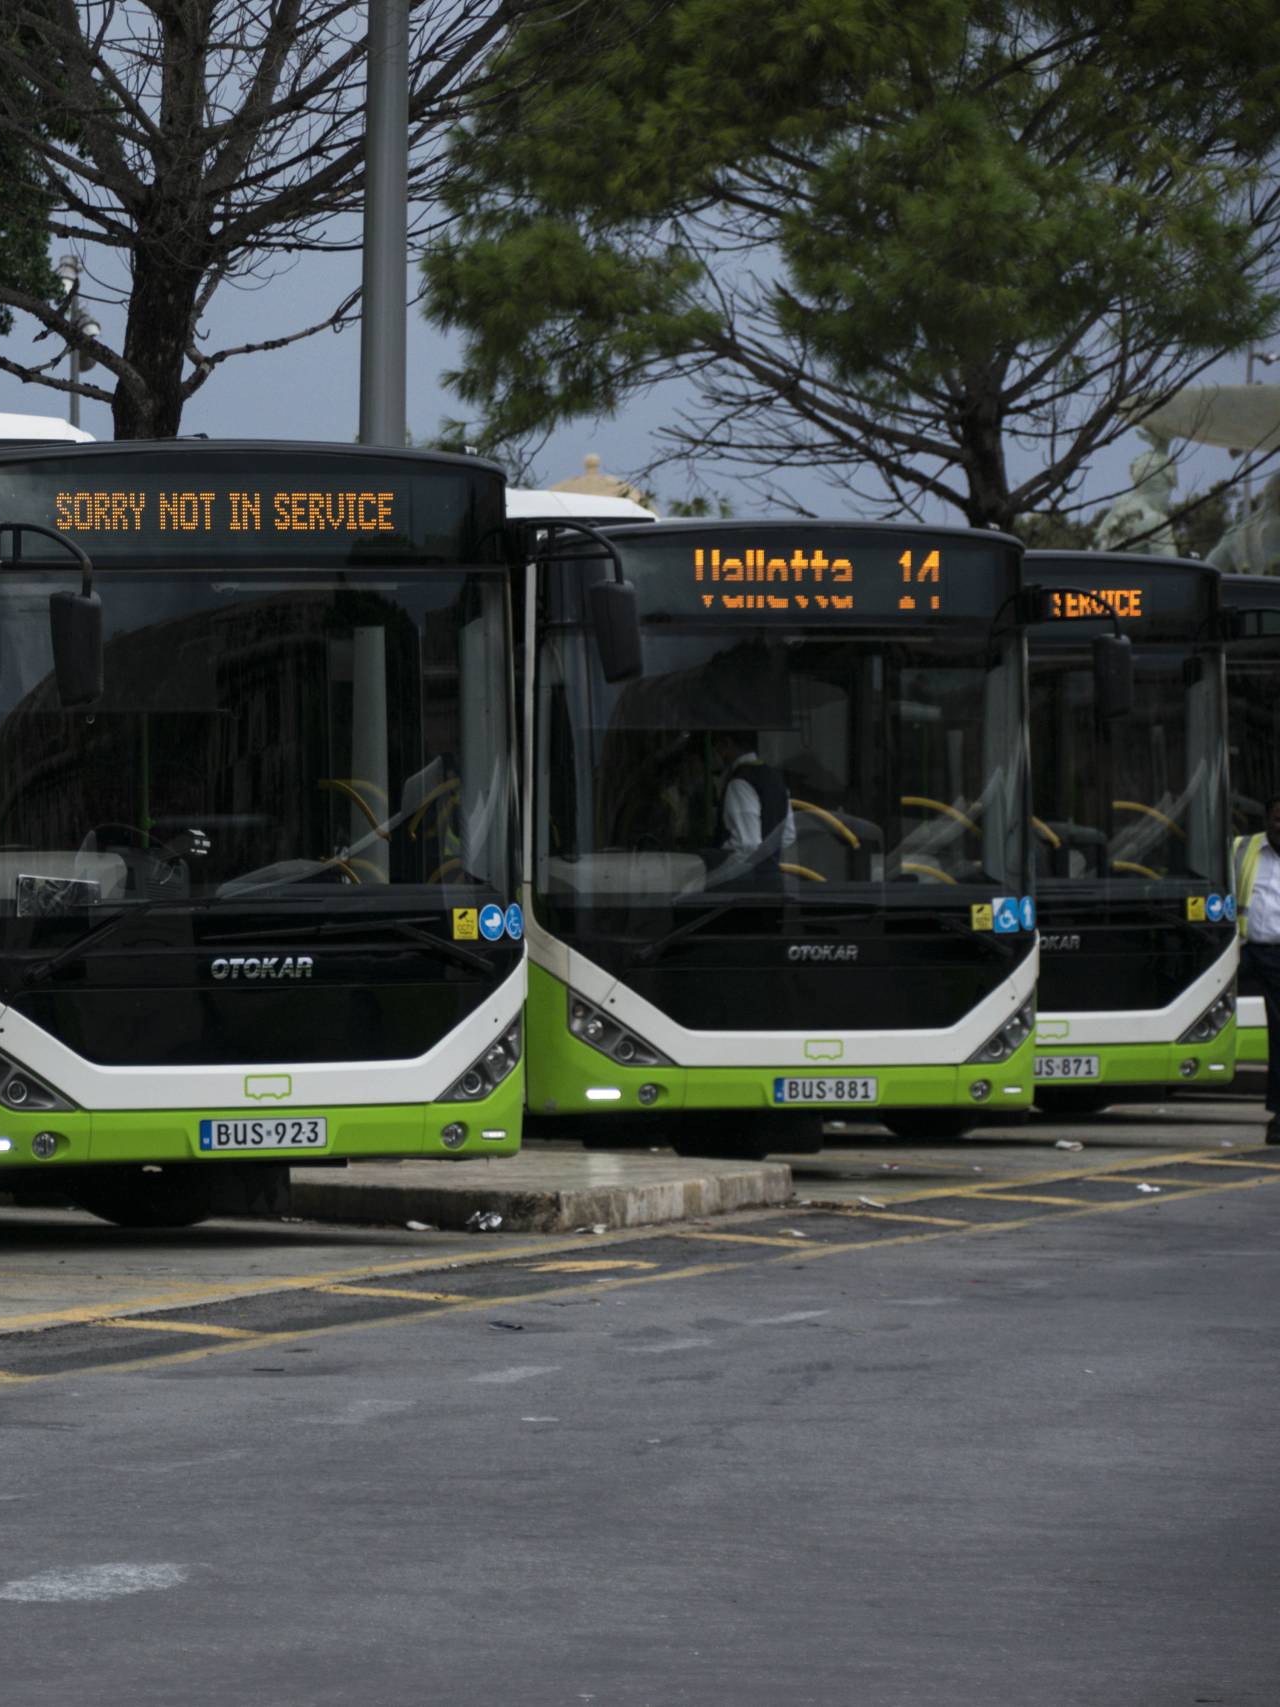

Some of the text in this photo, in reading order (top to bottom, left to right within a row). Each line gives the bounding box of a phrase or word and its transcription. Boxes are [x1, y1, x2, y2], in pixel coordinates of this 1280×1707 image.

[56, 492, 395, 530] SORRY NOT IN SERVICE
[1039, 935, 1081, 950] OKAR
[787, 945, 859, 961] OTOKAR
[210, 957, 314, 979] OTOKAR
[1034, 1058, 1055, 1076] US
